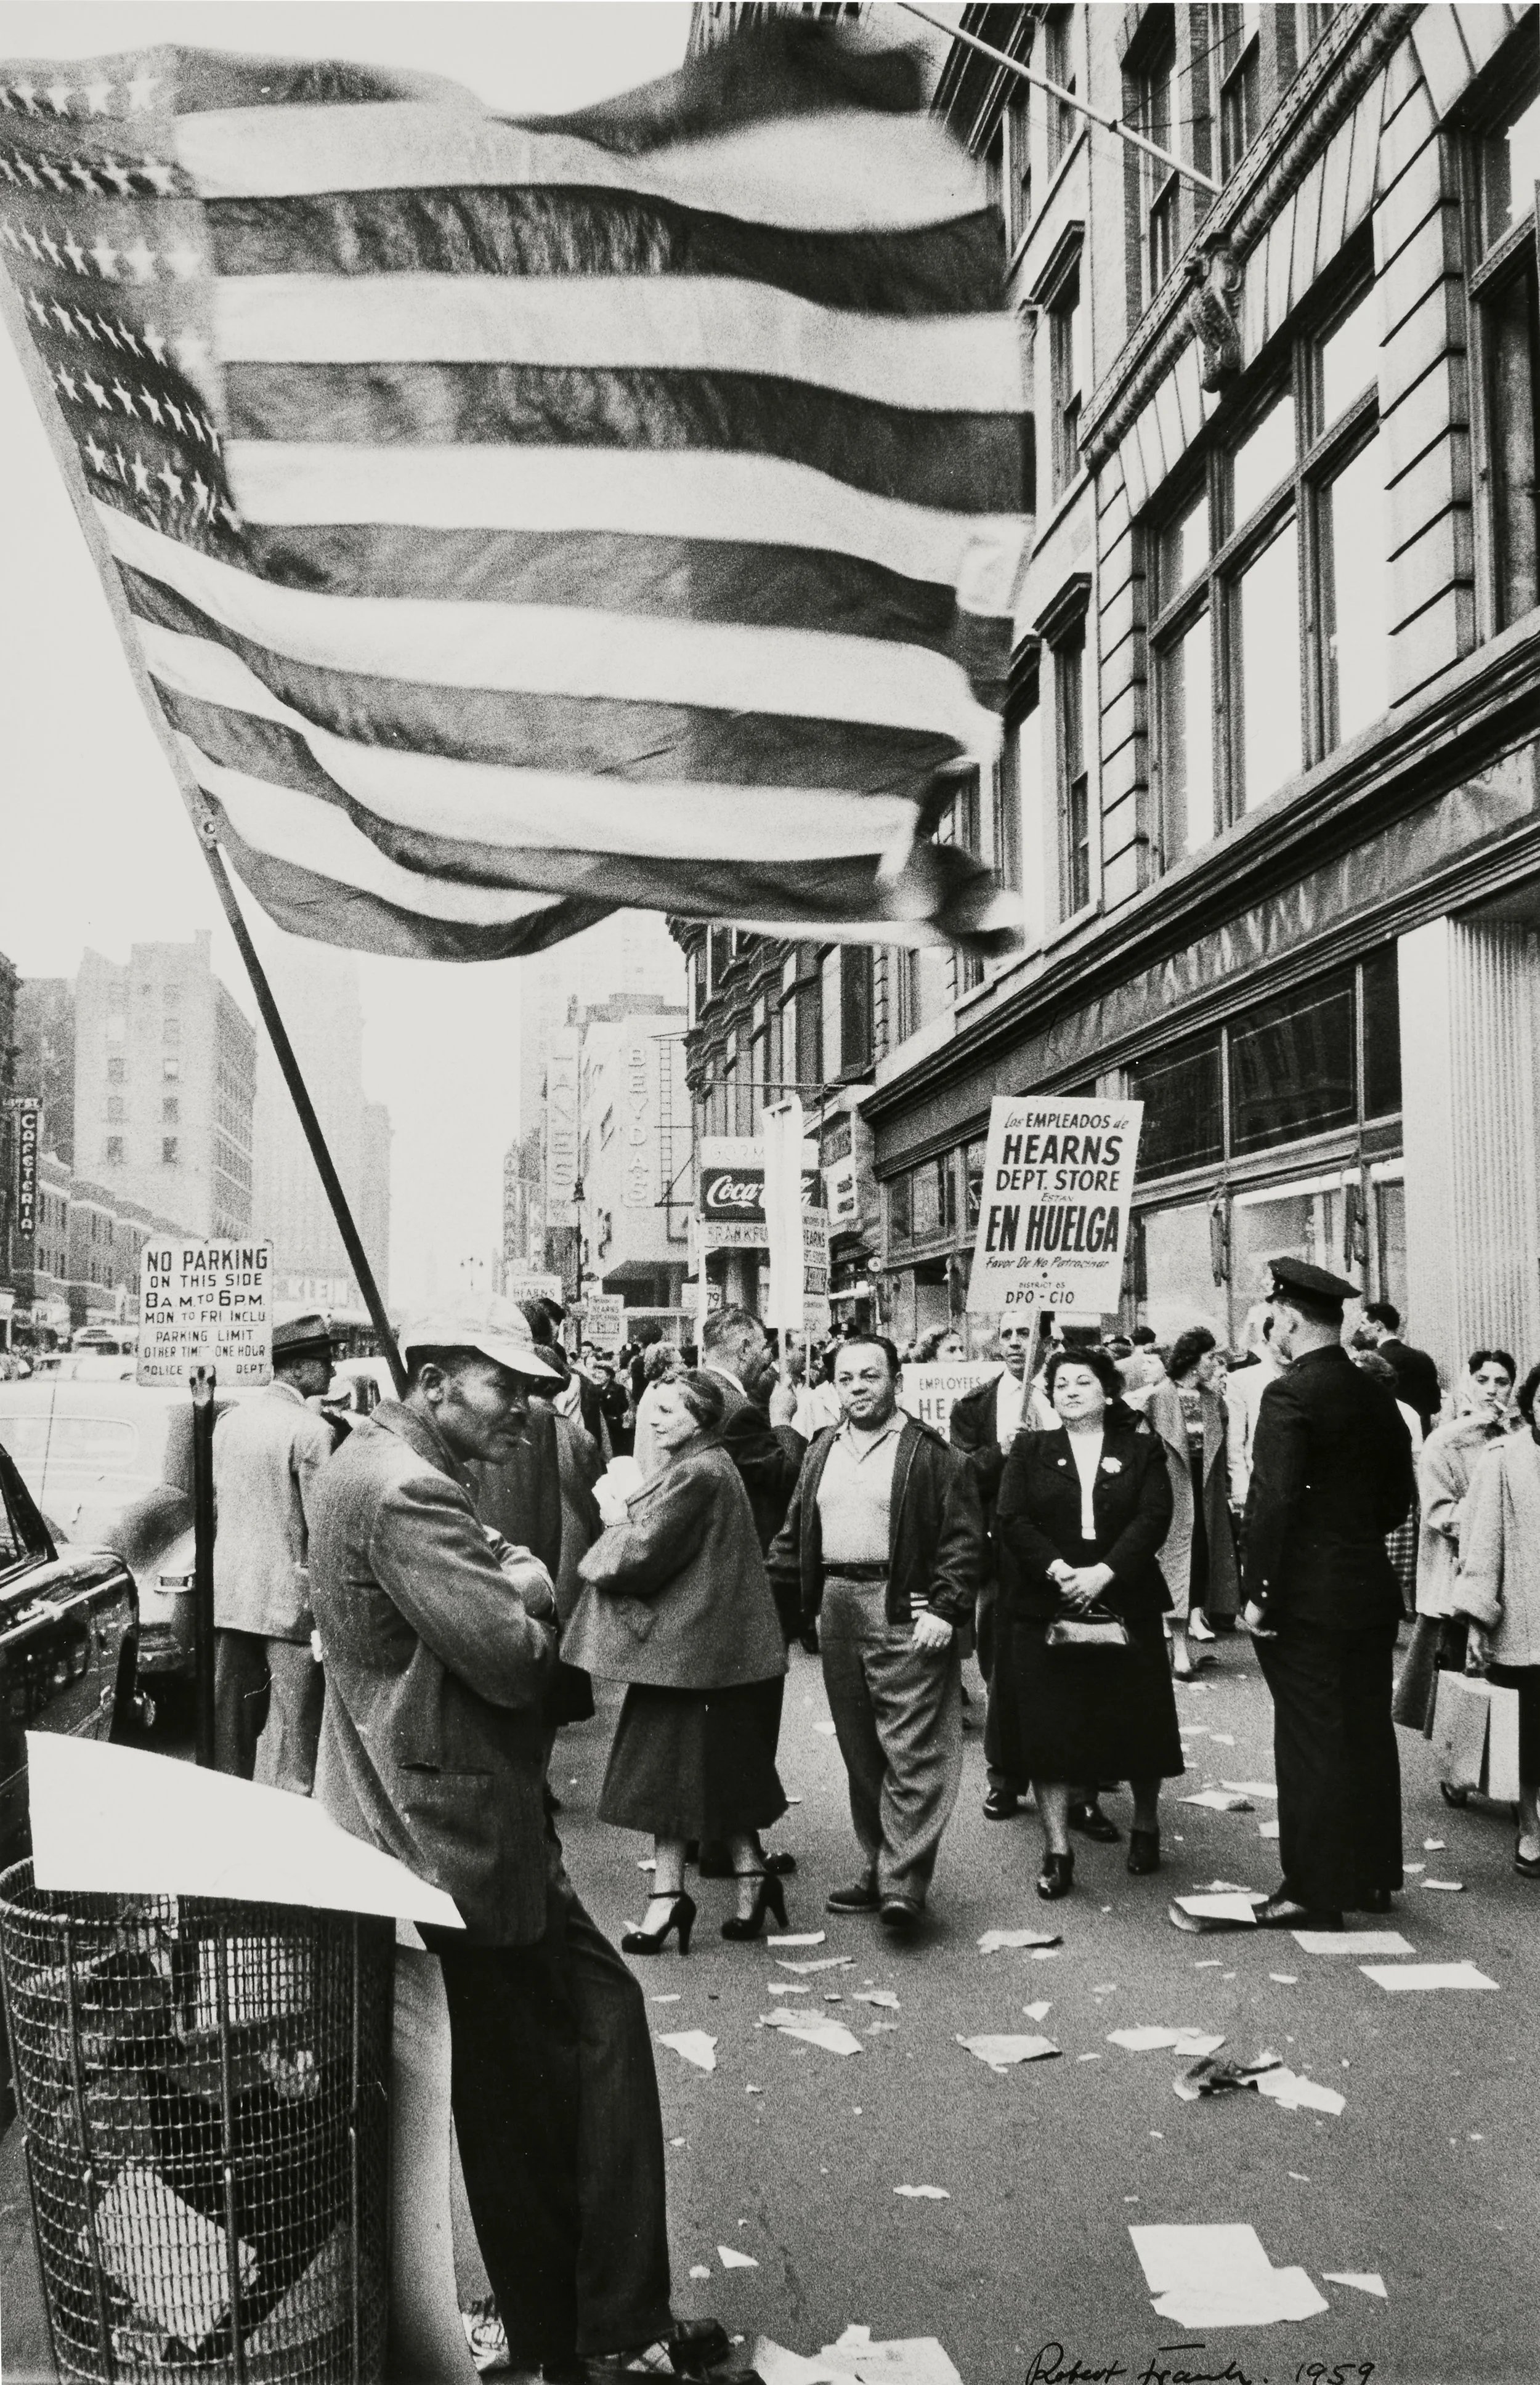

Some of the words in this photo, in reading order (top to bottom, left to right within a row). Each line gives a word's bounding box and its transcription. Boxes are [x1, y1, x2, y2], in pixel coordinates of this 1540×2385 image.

[1026, 1112, 1111, 1128] EMPLEADOS
[1114, 1115, 1129, 1129] de
[1002, 1134, 1123, 1165] HEARNS
[996, 1169, 1048, 1191] DEPT.
[1054, 1169, 1120, 1191] STORE
[708, 1226, 768, 1243] FRANKFU
[985, 1205, 1020, 1252] EN
[1025, 1205, 1119, 1252] HUELGA
[147, 1251, 172, 1272] NO
[184, 1248, 267, 1271] PARKING
[986, 1256, 1015, 1269] Favor
[1016, 1255, 1031, 1268] De
[1032, 1257, 1048, 1268] No
[1050, 1256, 1109, 1268] Patrocinar
[151, 1276, 170, 1288] ON
[180, 1274, 216, 1287] THIS
[225, 1273, 262, 1287] SIDE
[198, 1293, 214, 1305] TO
[1005, 1290, 1034, 1303] DPO
[1049, 1290, 1074, 1304] CIO
[182, 1311, 195, 1321] TO
[201, 1311, 222, 1322] FRI
[156, 1330, 208, 1342] PARKING
[218, 1330, 254, 1341] LIMIT
[144, 1346, 176, 1358] OTHER
[182, 1346, 209, 1358] TIM
[216, 1346, 234, 1356] ONE
[238, 1345, 265, 1356] HOUR
[144, 1365, 183, 1375] POLICE
[919, 1377, 981, 1390] EMPLOYEES
